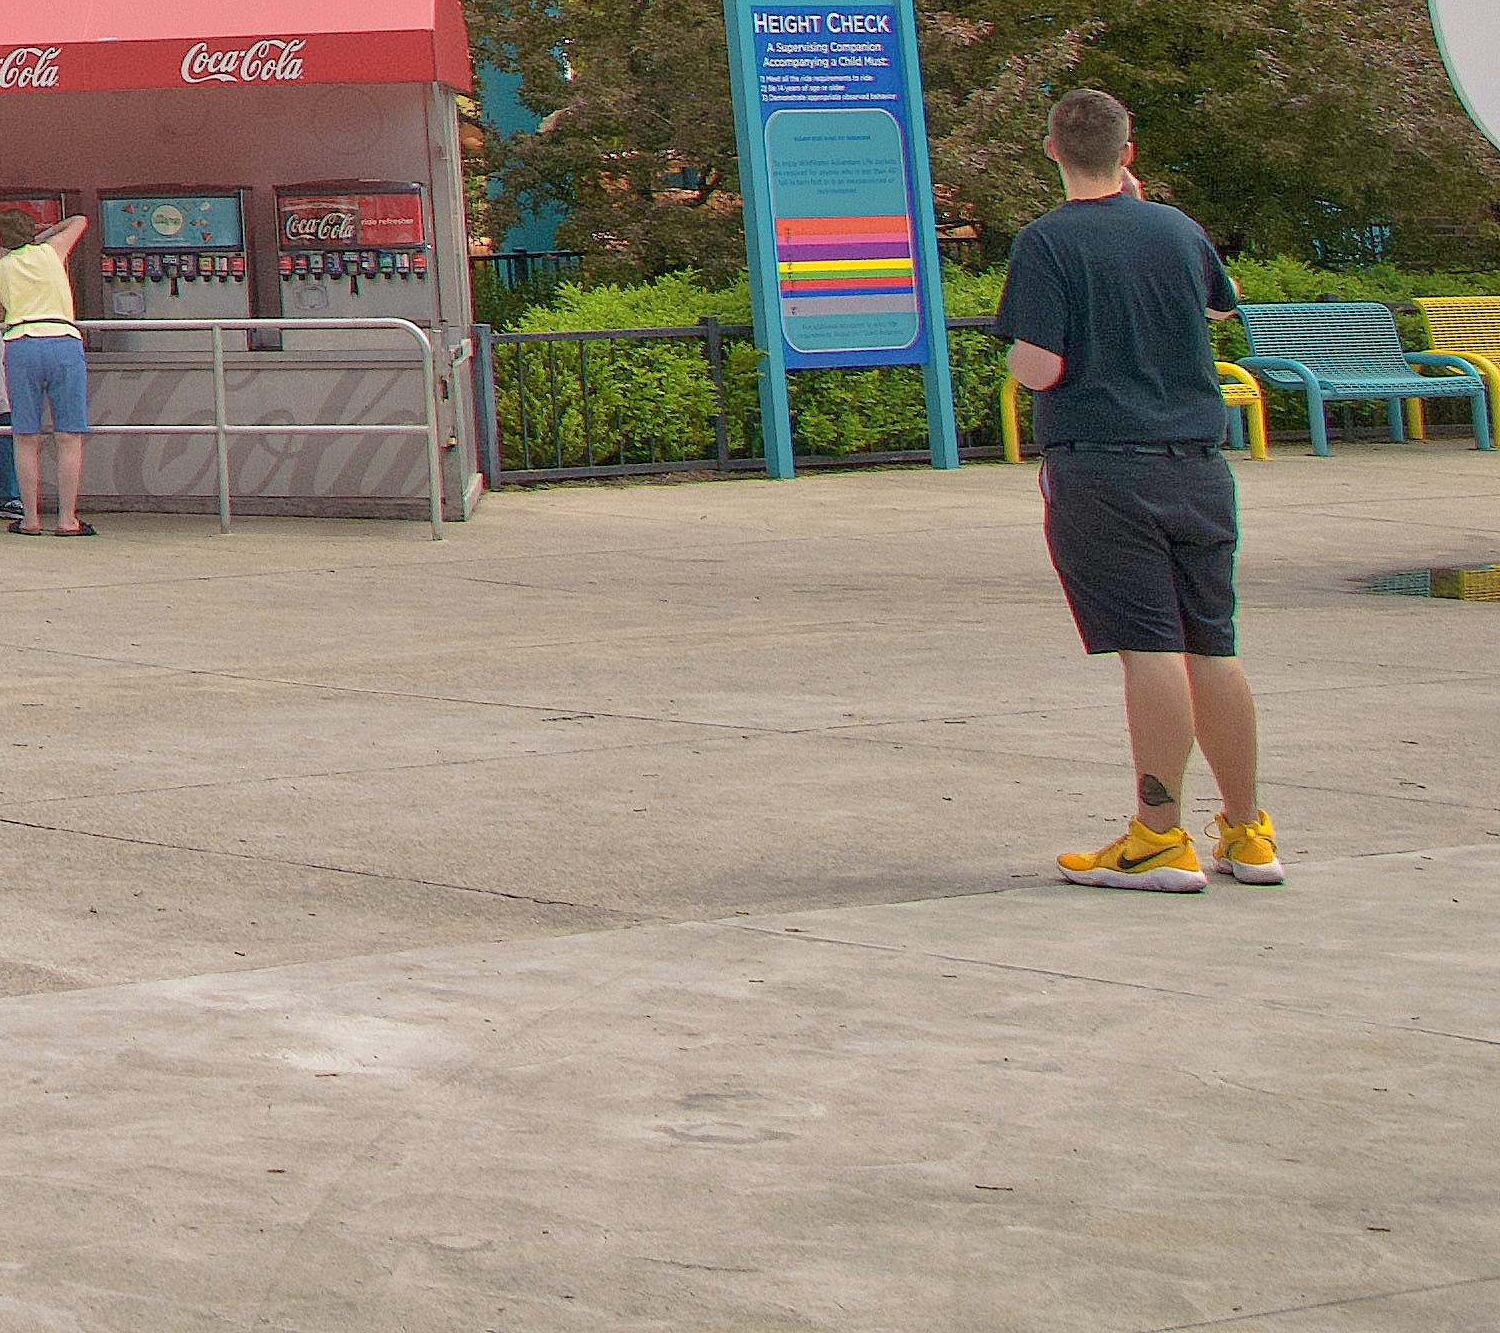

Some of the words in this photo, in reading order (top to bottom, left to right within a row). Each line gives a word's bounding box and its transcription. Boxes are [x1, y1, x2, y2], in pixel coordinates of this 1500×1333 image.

[753, 12, 822, 34] HEIGHT
[826, 12, 892, 34] CHECK
[766, 43, 775, 53] A
[776, 42, 829, 54] Supervising
[830, 42, 882, 54] Companion
[179, 38, 307, 84] Coca-Cola
[762, 57, 829, 69] Accompanying
[831, 59, 838, 67] a
[838, 57, 863, 67] Child
[284, 211, 357, 241] Coca-Cola
